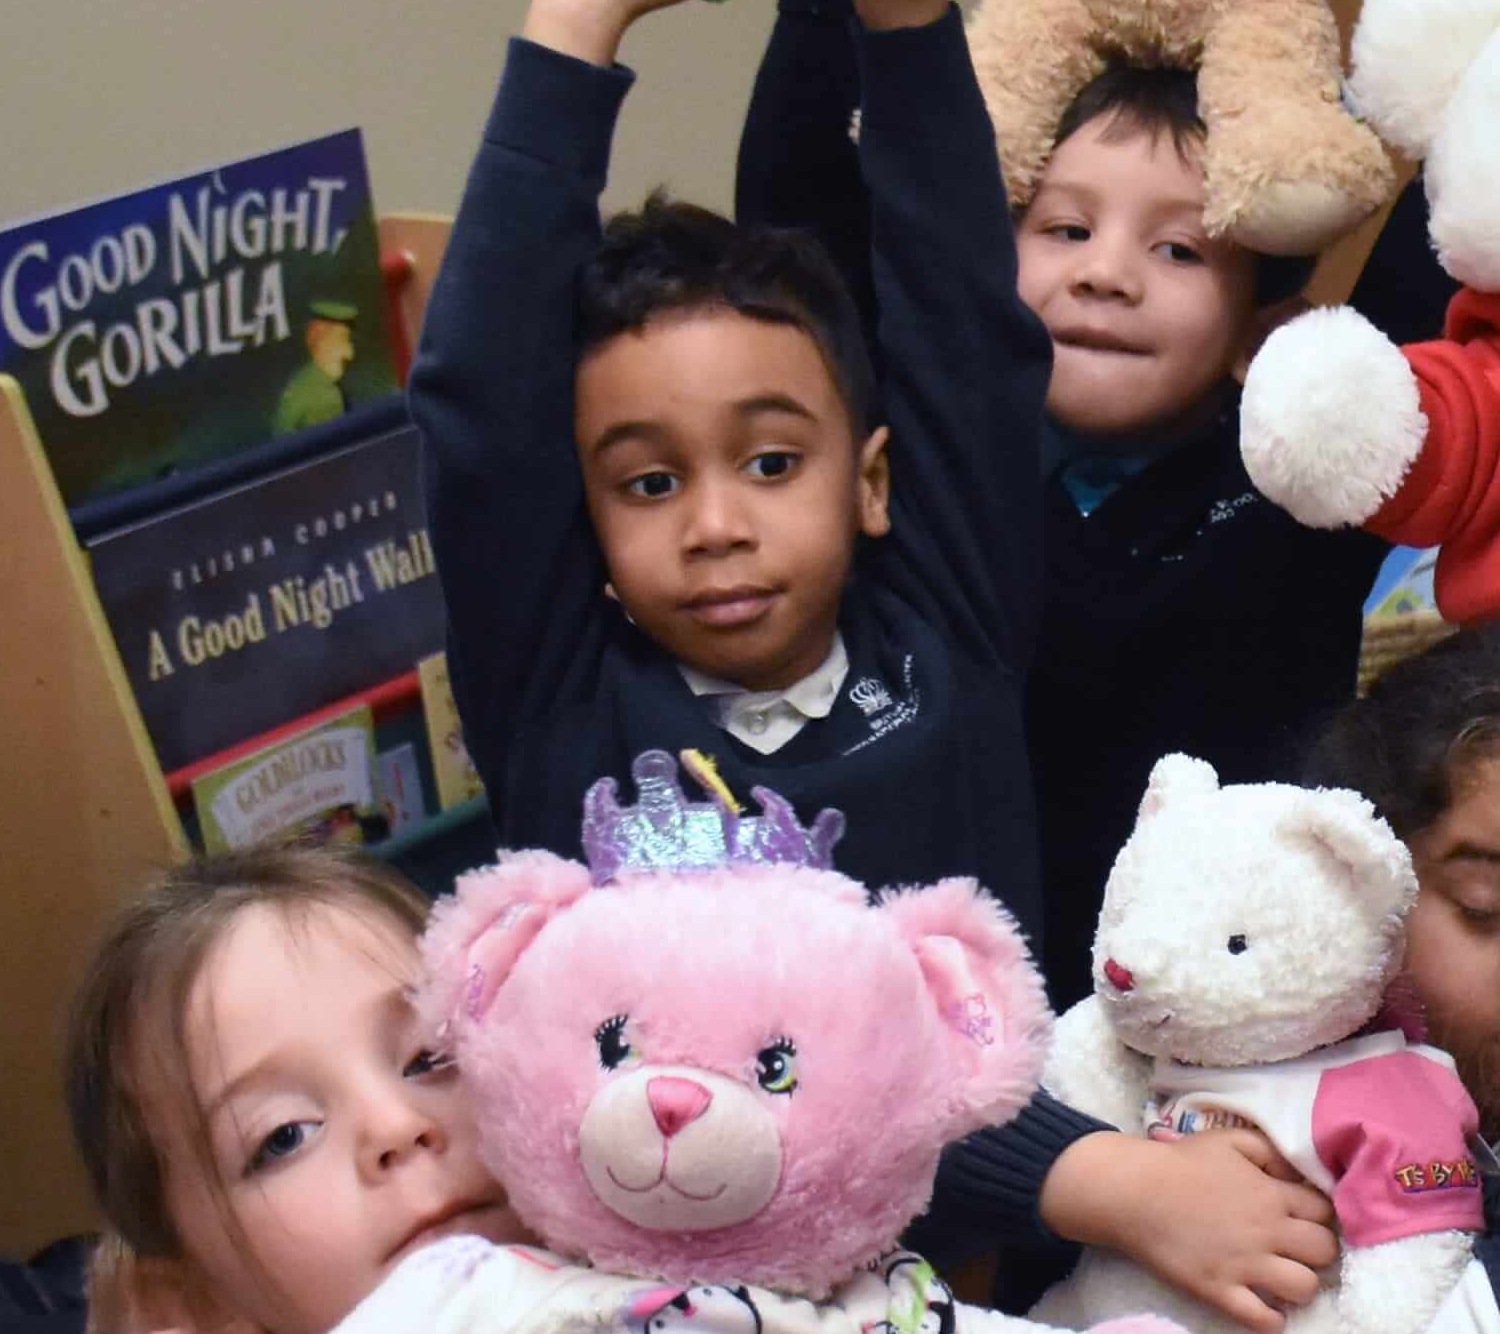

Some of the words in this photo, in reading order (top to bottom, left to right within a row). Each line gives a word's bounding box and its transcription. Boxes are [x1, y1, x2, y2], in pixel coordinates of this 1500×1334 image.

[51, 261, 292, 418] GORILLA
[295, 490, 397, 545] COOPER
[148, 629, 175, 682] A
[177, 592, 267, 667] Good
[268, 560, 365, 634] Night
